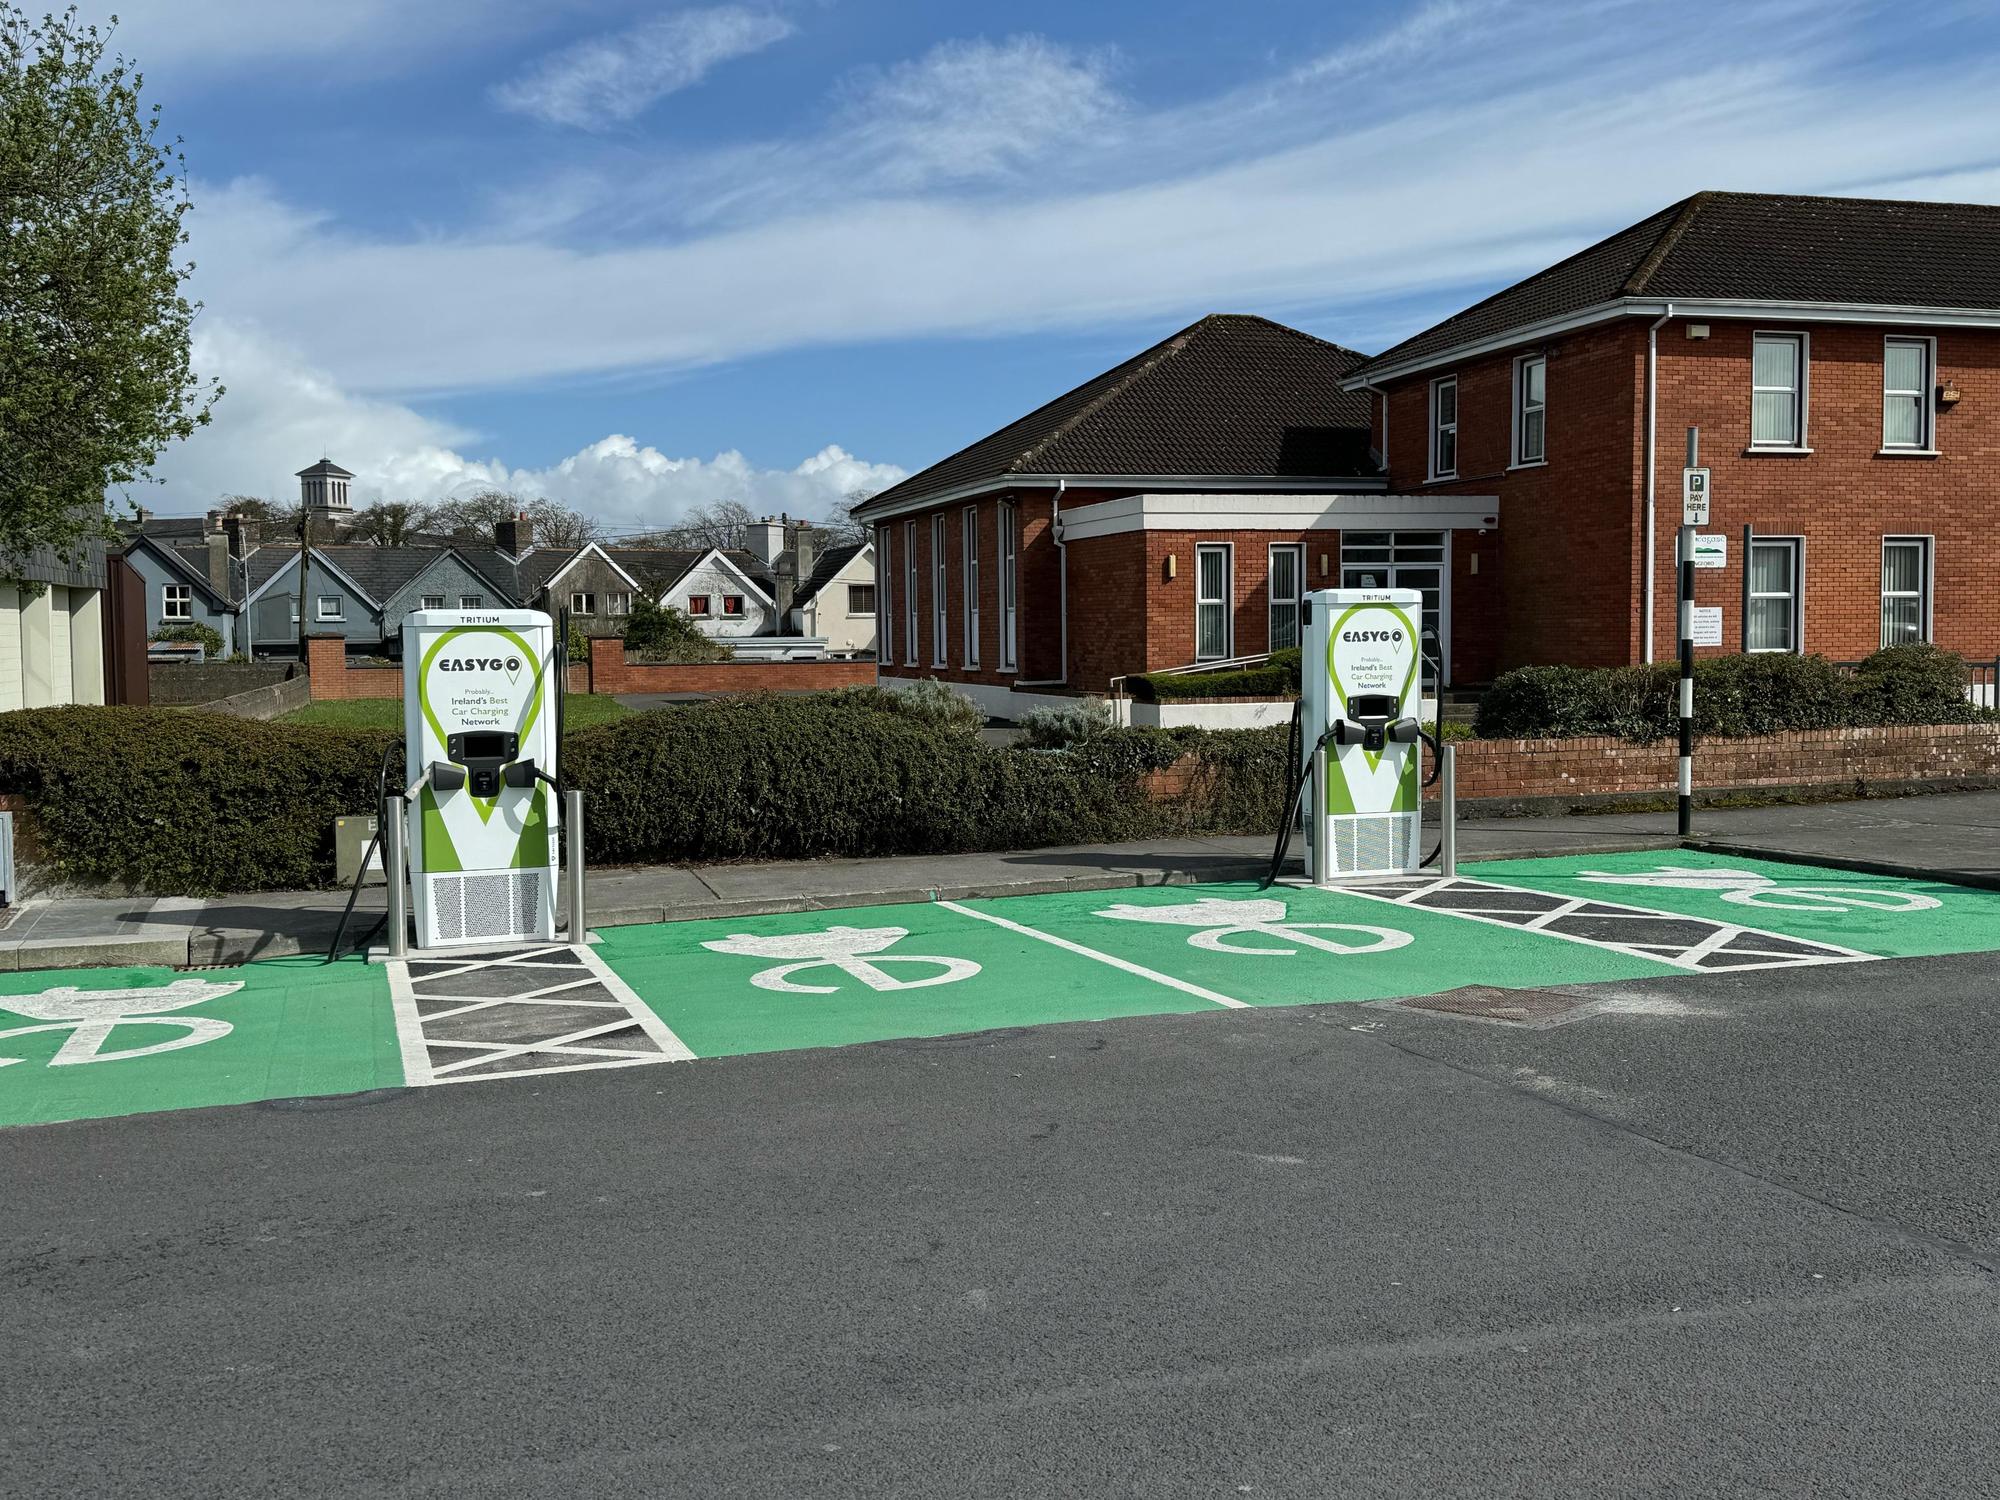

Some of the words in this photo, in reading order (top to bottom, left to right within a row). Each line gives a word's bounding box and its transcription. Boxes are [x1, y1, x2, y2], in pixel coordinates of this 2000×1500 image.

[1692, 476, 1701, 490] P
[1690, 494, 1704, 502] PAY
[1686, 503, 1707, 511] HERE
[1343, 631, 1402, 642] EASYGO
[438, 658, 520, 672] EASYGO
[1364, 673, 1393, 681] Charging
[470, 708, 509, 716] Charging
[461, 718, 500, 726] Network
